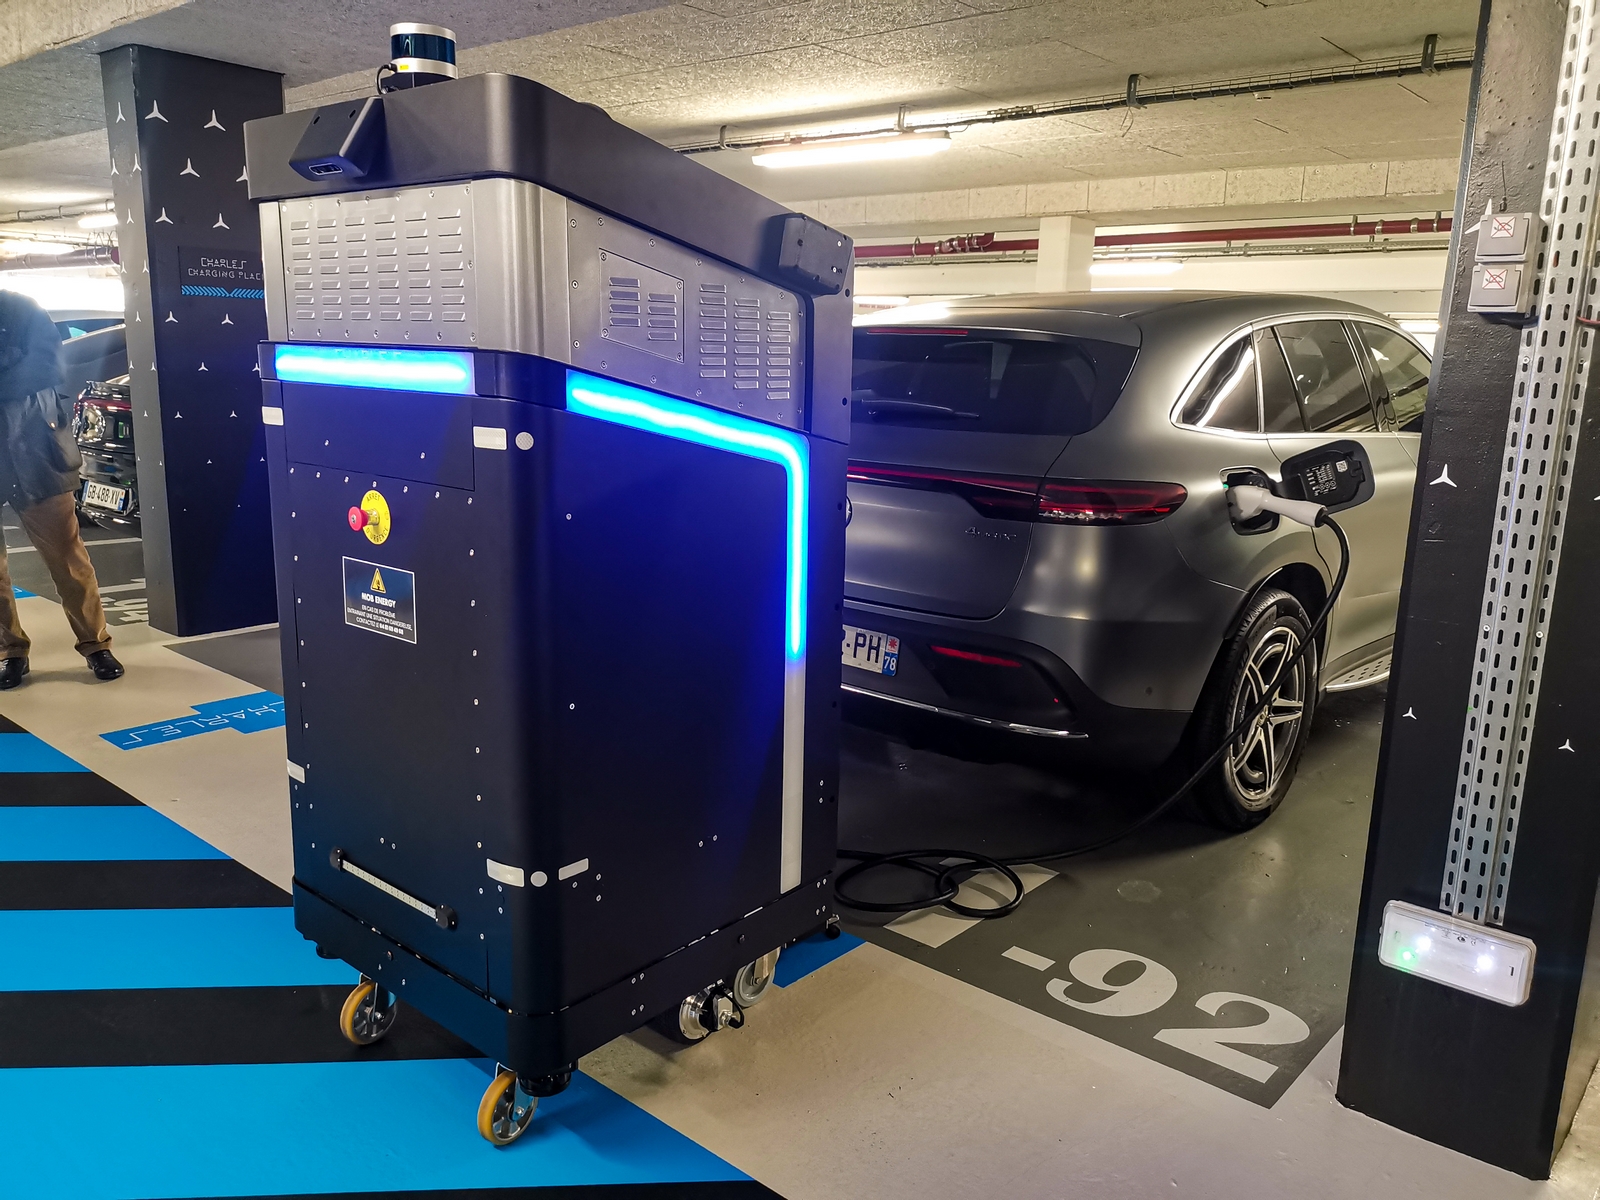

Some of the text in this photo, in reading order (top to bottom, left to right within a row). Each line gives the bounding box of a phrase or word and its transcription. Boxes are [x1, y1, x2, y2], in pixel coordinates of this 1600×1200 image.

[201, 257, 247, 269] CHARLES
[188, 268, 263, 281] CHARGING PLAC
[361, 592, 396, 608] MOB ENERGY
[884, 655, 897, 671] 78
